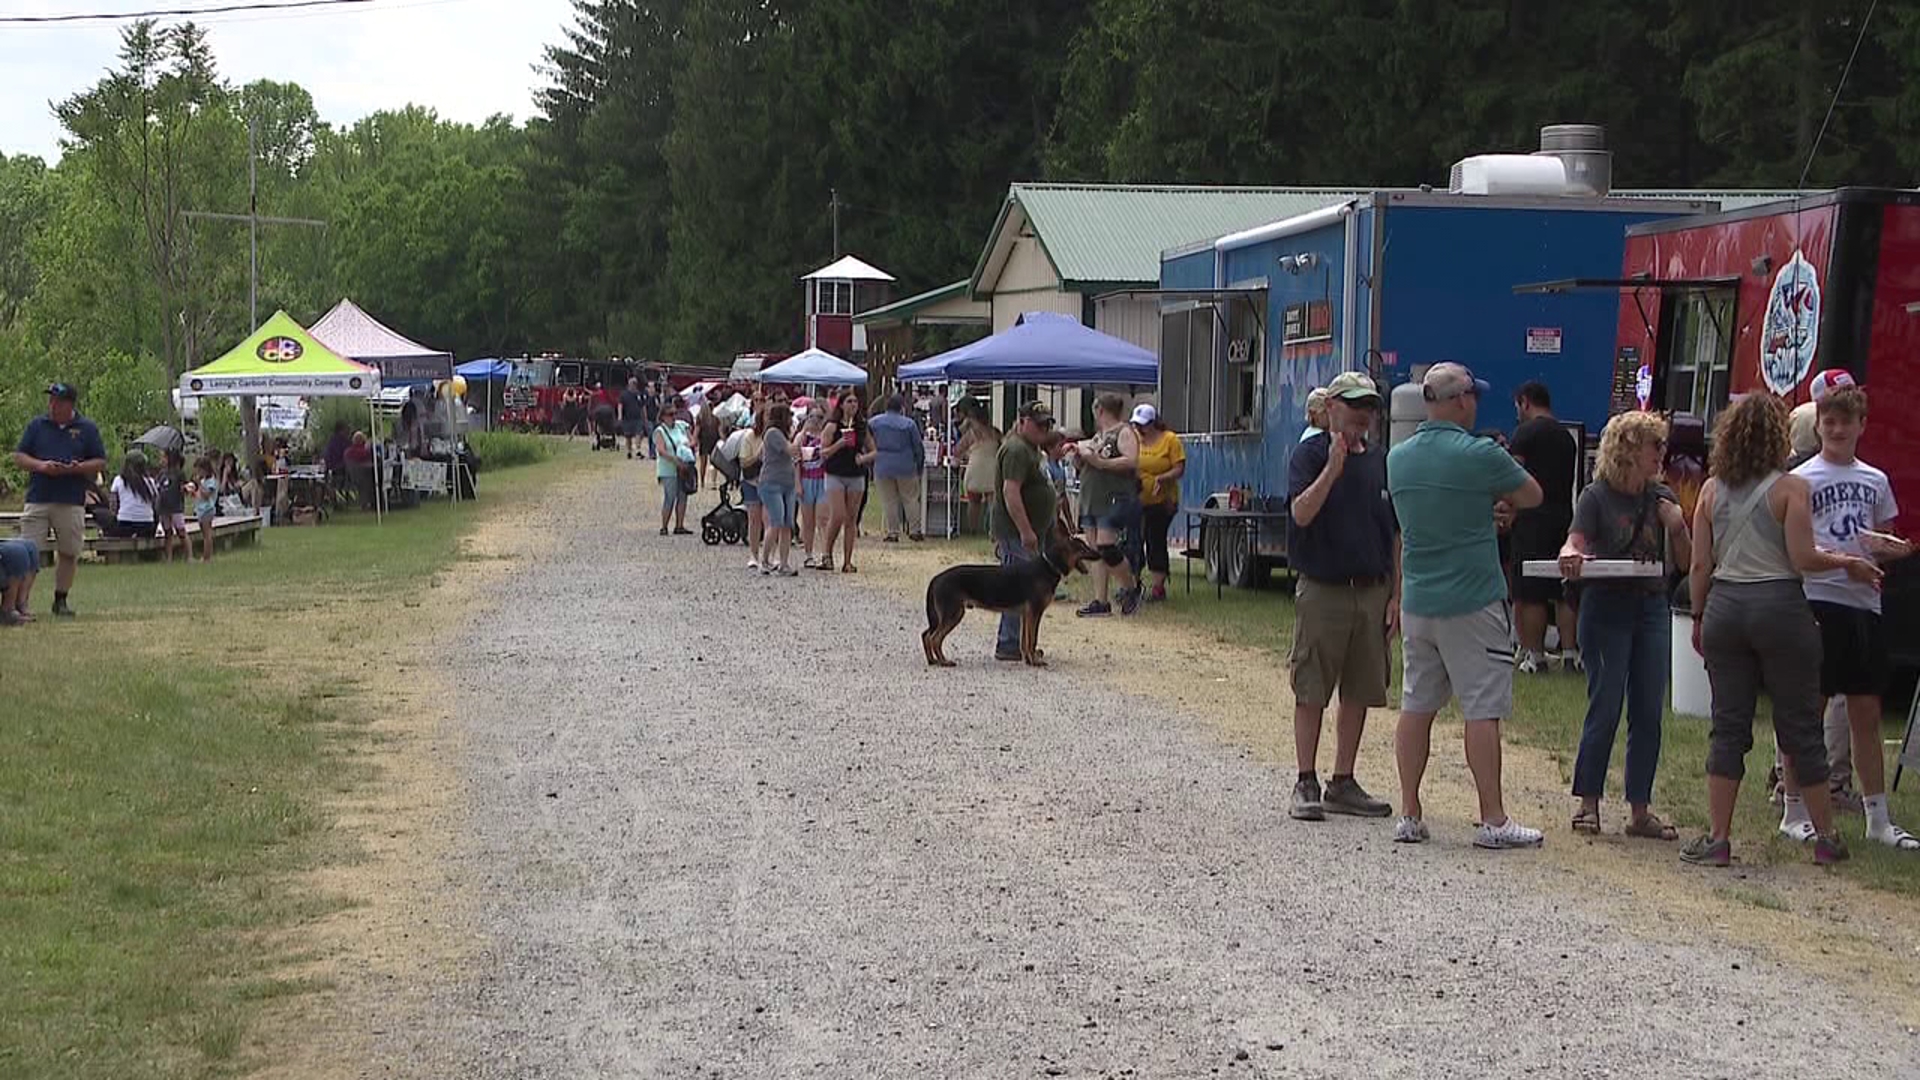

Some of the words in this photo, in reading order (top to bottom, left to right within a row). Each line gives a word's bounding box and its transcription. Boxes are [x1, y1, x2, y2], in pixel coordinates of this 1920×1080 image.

[209, 379, 237, 389] Lehigh
[239, 379, 267, 387] Carbon
[269, 378, 312, 389] Community
[315, 378, 343, 388] College
